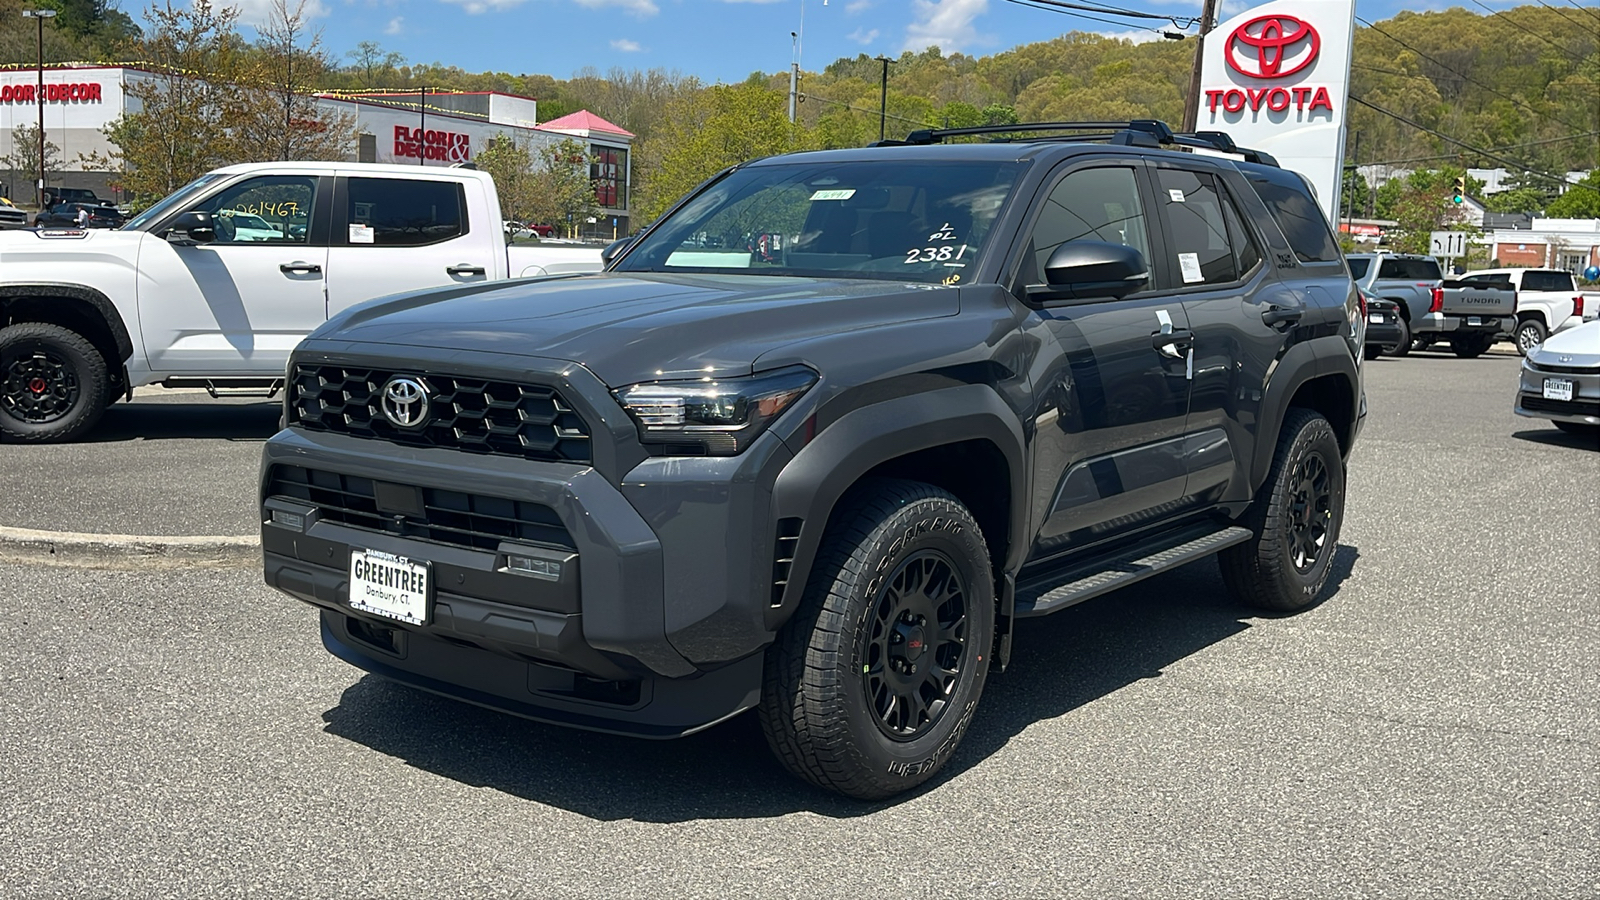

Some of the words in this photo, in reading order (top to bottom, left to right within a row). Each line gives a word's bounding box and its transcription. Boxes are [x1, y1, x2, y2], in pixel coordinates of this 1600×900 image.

[0, 84, 36, 102] OOR
[48, 83, 101, 101] DECOR
[1205, 87, 1333, 113] TOYOTA
[394, 125, 447, 146] FLOOR
[394, 141, 447, 161] DECOR
[904, 244, 968, 264] 2381
[355, 559, 424, 595] GREENTREE
[366, 585, 398, 604] Danbury,
